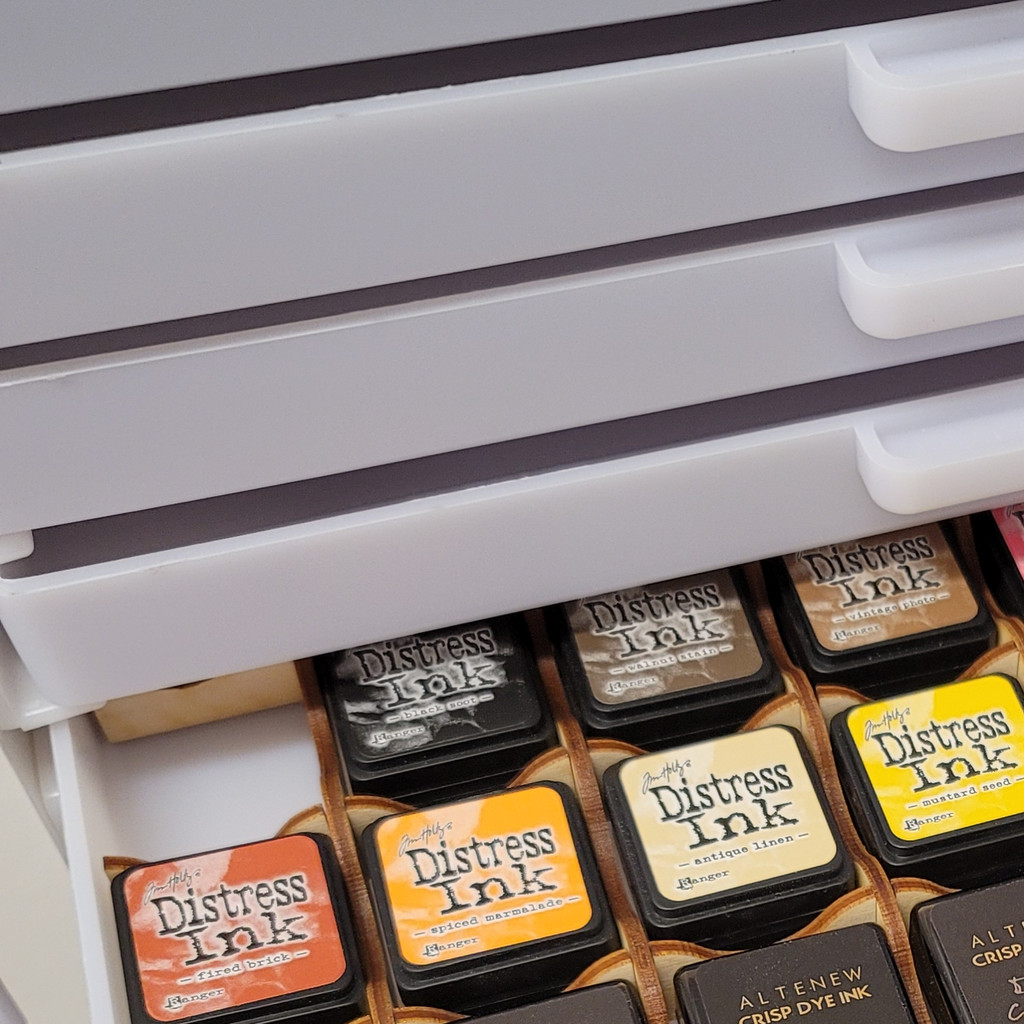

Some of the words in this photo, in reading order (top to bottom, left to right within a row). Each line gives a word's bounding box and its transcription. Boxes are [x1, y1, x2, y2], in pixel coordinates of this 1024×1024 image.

[803, 537, 934, 584] Distress
[584, 584, 720, 633] Distress
[830, 566, 941, 607] Ink
[850, 604, 897, 621] vintage
[903, 597, 936, 611] photo
[353, 629, 495, 683] Distress
[609, 615, 724, 657] Ink
[628, 656, 675, 671] walnut
[681, 648, 716, 660] stain
[377, 660, 496, 708] Ink
[404, 705, 443, 719] black
[449, 697, 476, 710] soot
[872, 712, 1010, 767] Distress
[901, 745, 1018, 792] Ink
[649, 764, 793, 822] Distress
[923, 787, 977, 807] mustard
[983, 779, 1011, 791] seed
[676, 798, 799, 849] Ink
[405, 828, 555, 886] Distress
[694, 847, 748, 866] antique
[754, 835, 793, 850] linen
[151, 875, 307, 935] Distress
[431, 864, 557, 915] Ink
[175, 912, 308, 966] Ink
[431, 917, 479, 934] spiced
[486, 898, 563, 921] marmalade
[198, 964, 241, 980] fired
[248, 953, 291, 969] brick
[971, 945, 1022, 967] CRISP
